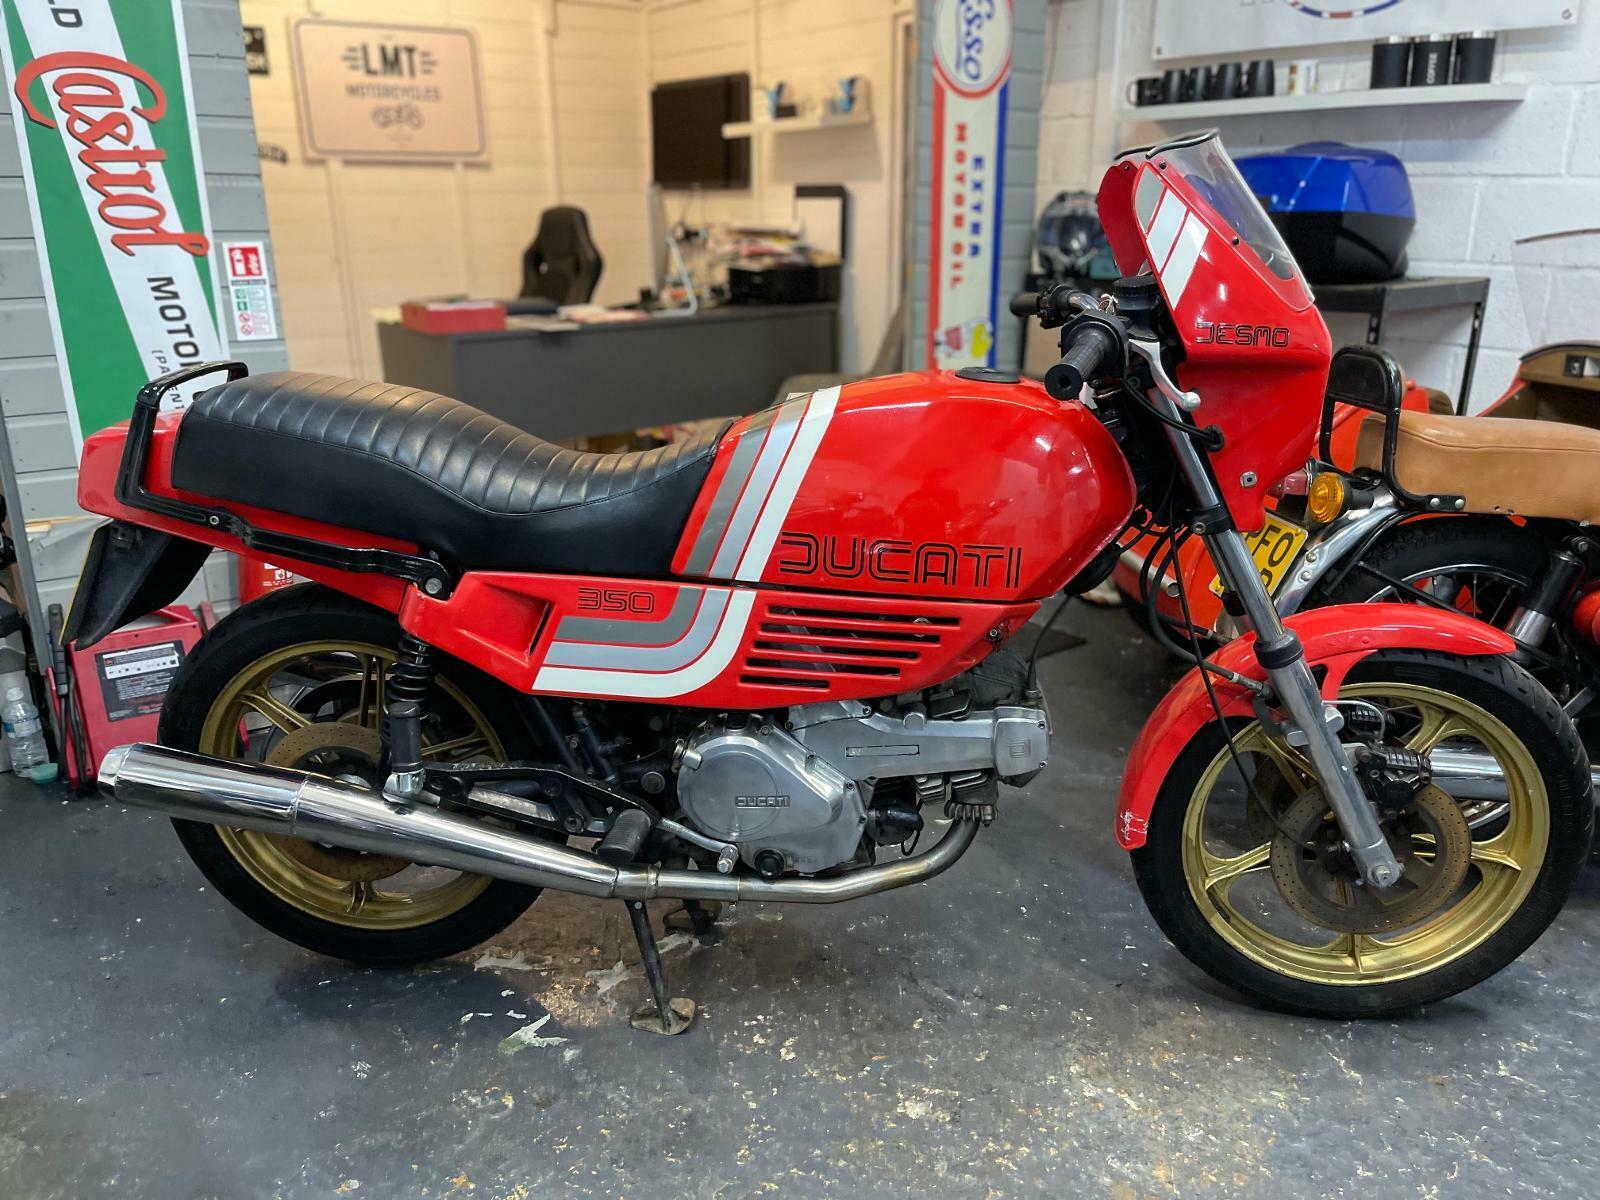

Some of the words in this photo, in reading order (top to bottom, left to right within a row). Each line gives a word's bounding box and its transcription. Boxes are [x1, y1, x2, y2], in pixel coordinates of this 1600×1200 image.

[48, 0, 83, 28] D
[360, 42, 417, 78] LMT
[14, 51, 210, 256] Castrol
[953, 122, 967, 229] MOTOR
[971, 155, 985, 257] EXTRA
[951, 241, 963, 289] OIL
[1195, 321, 1290, 347] DESMO
[780, 532, 1022, 588] DUCATI
[577, 588, 654, 613] 350
[737, 796, 788, 808] DUCATI
